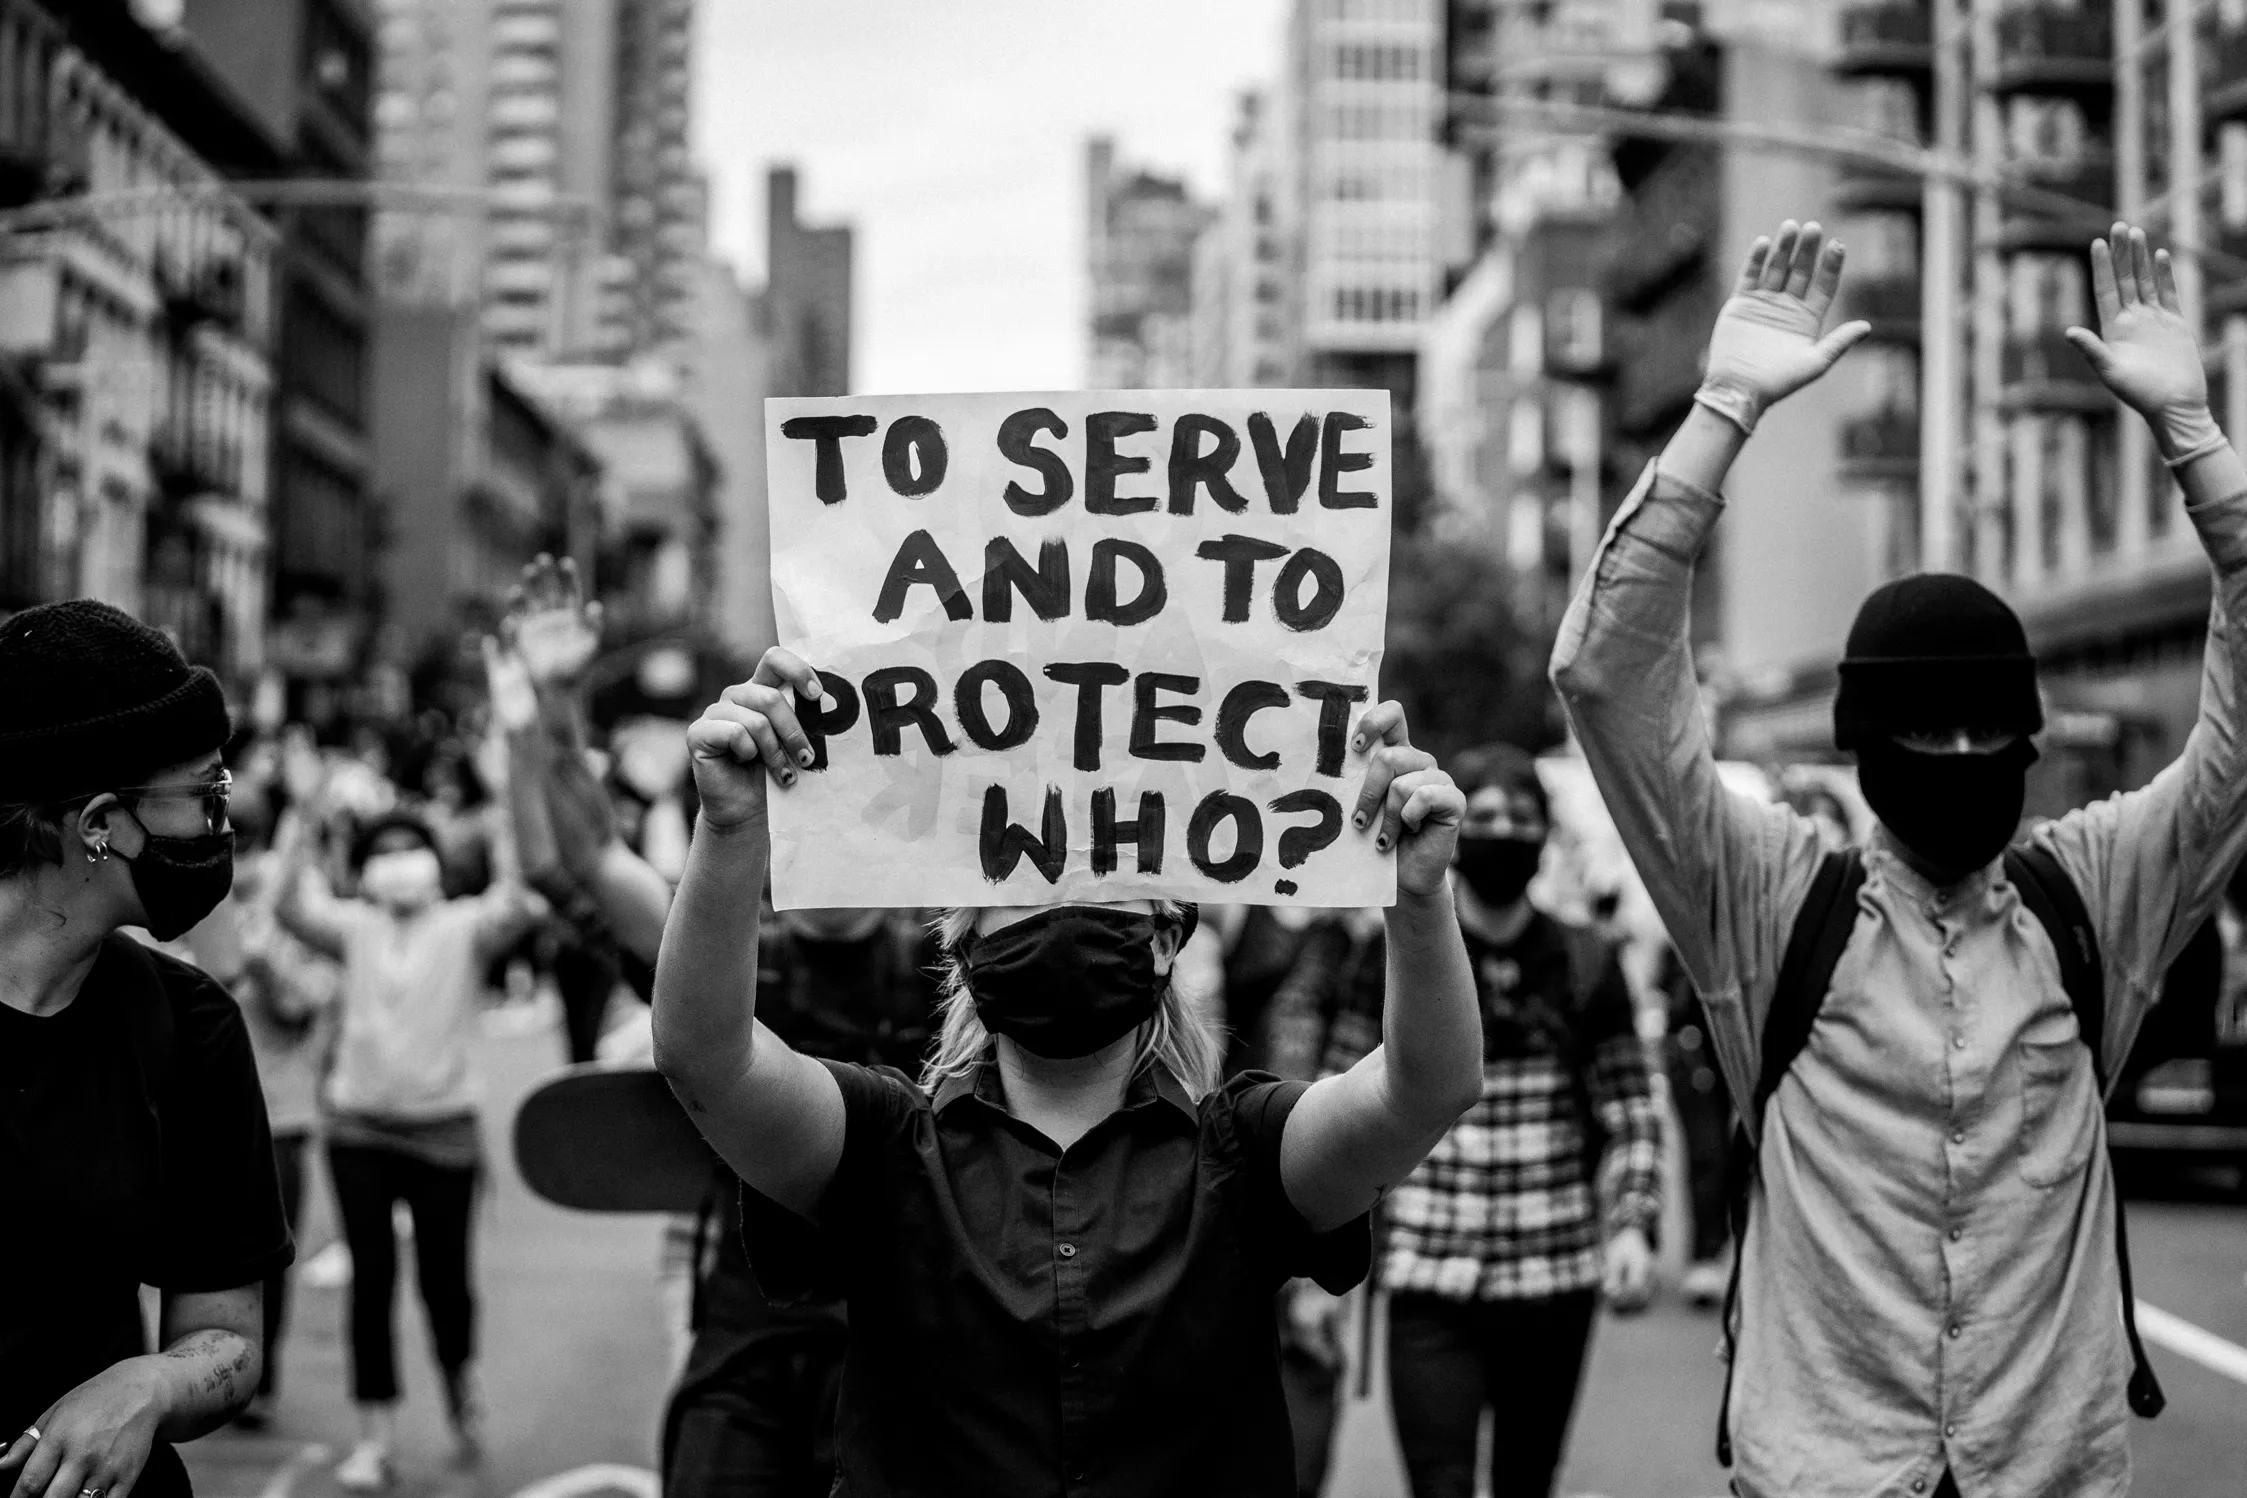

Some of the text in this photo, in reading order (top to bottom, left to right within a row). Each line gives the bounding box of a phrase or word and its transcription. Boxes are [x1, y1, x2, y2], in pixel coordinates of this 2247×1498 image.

[780, 407, 1380, 517] TO SERVE
[871, 528, 1346, 633] AND TO
[793, 658, 1370, 778] PROTECT
[978, 782, 1345, 897] WHO?
